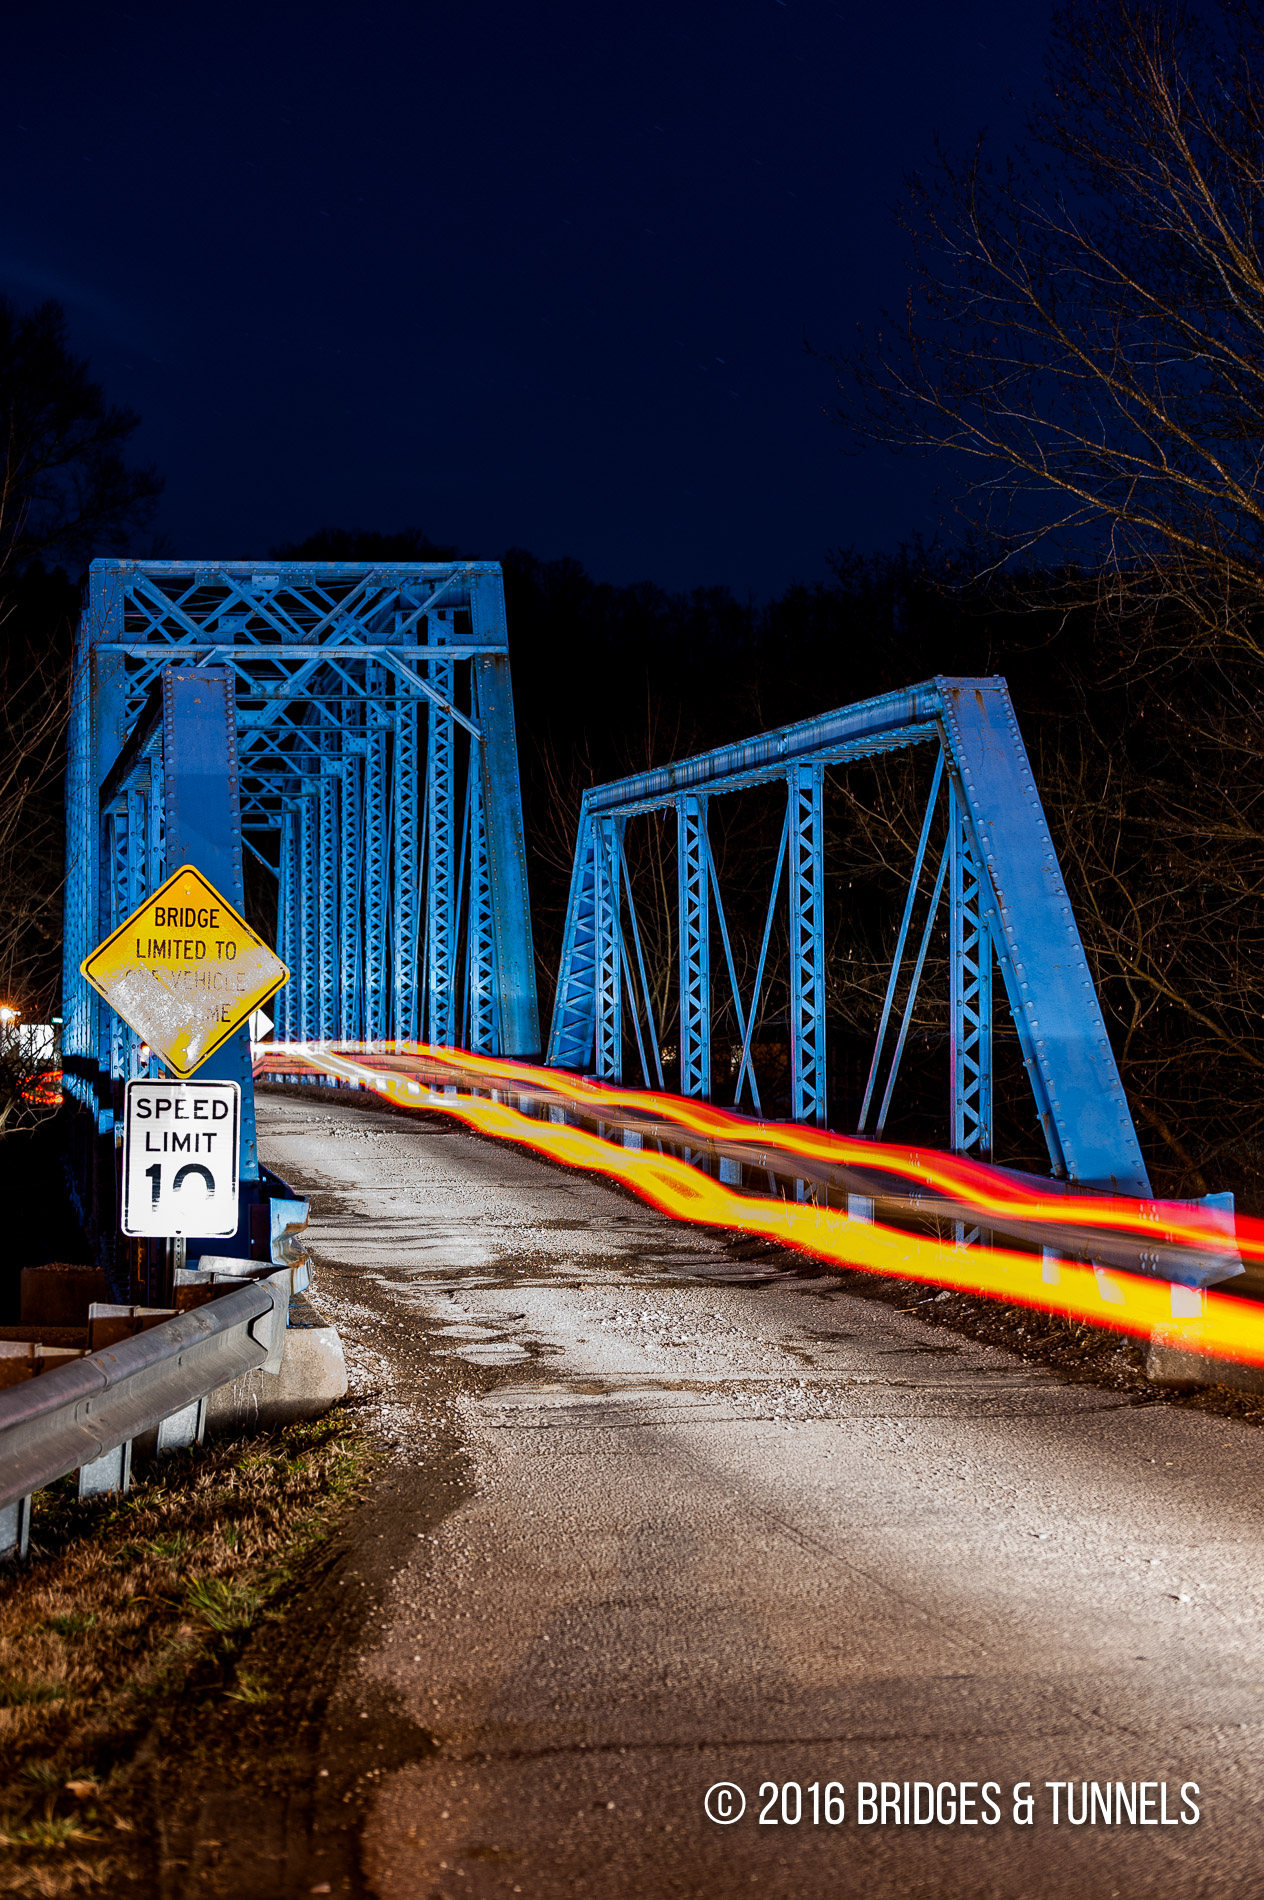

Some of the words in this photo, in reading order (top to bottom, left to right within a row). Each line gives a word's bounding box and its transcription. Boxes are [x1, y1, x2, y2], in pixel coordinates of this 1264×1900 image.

[154, 907, 220, 929] BRIDGE
[136, 938, 207, 960] LIMITED
[215, 940, 237, 961] TO
[136, 1098, 229, 1120] SPEED
[145, 1131, 218, 1153] LIMIT
[145, 1163, 216, 1213] 10
